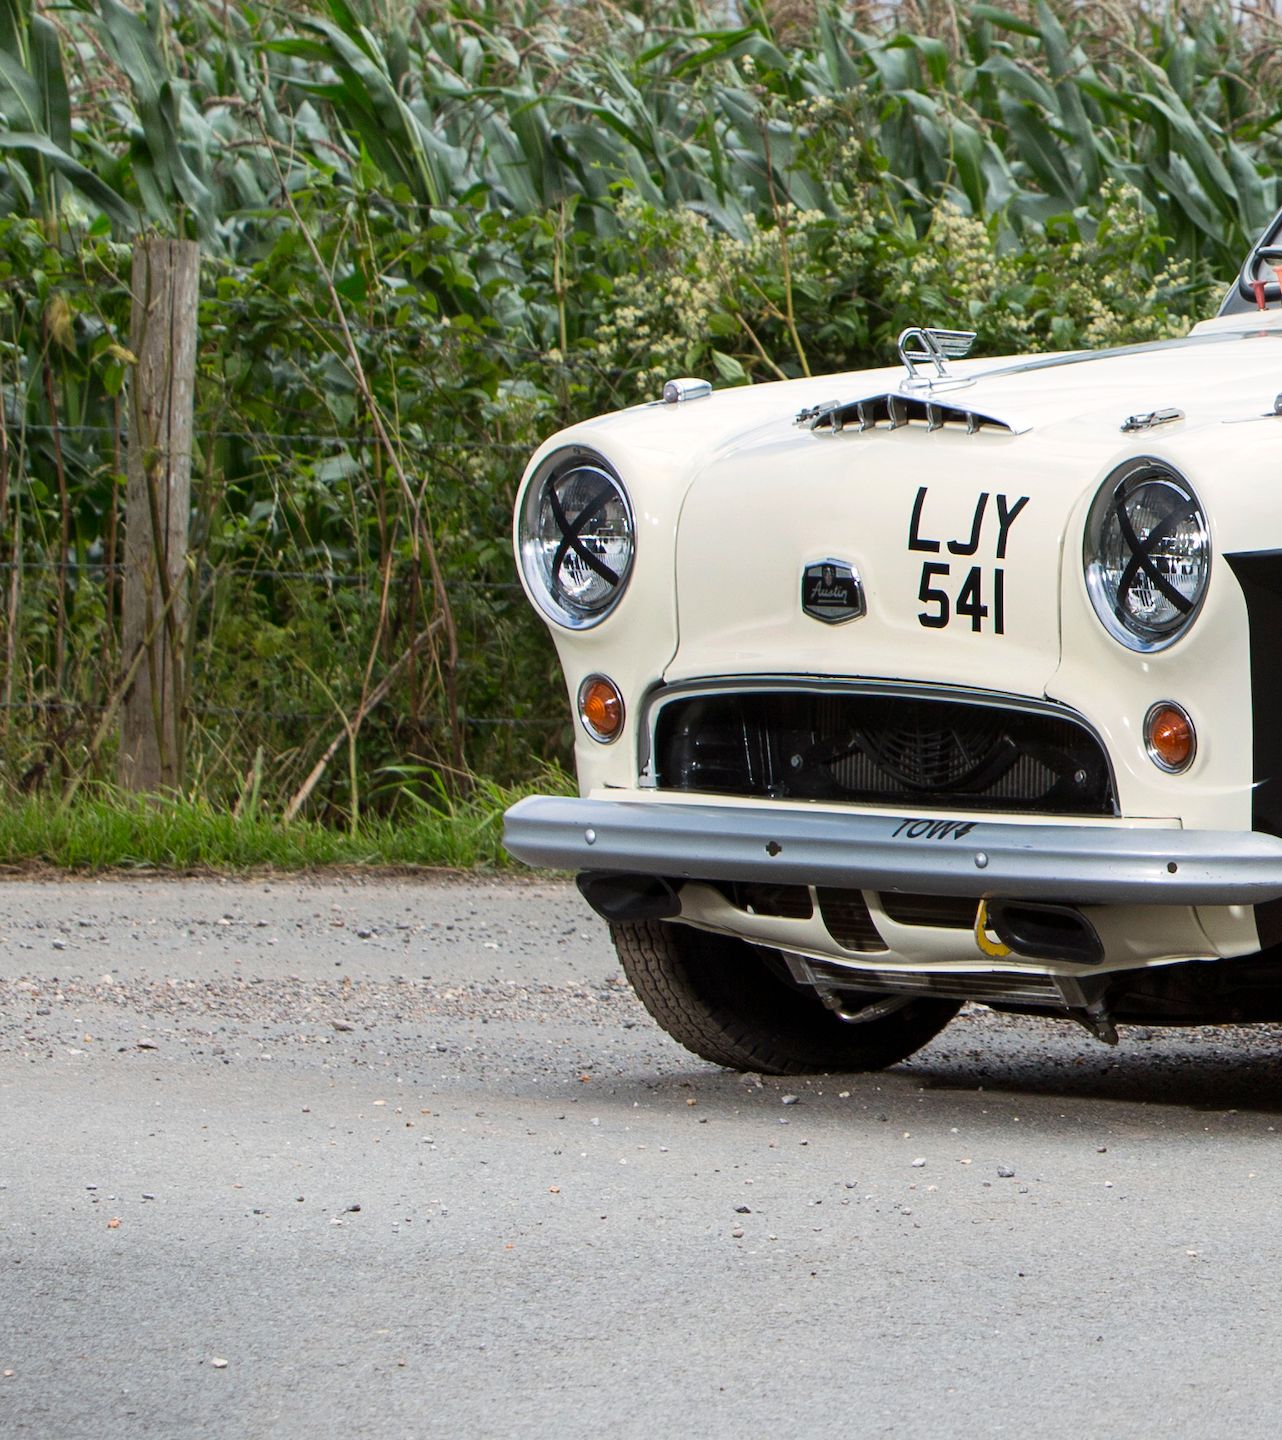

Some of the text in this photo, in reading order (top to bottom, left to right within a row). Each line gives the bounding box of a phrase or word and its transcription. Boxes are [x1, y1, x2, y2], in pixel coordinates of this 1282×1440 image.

[908, 486, 1031, 560] LJY
[810, 580, 848, 604] Austin
[917, 561, 1005, 635] 541
[892, 818, 962, 840] TOW
